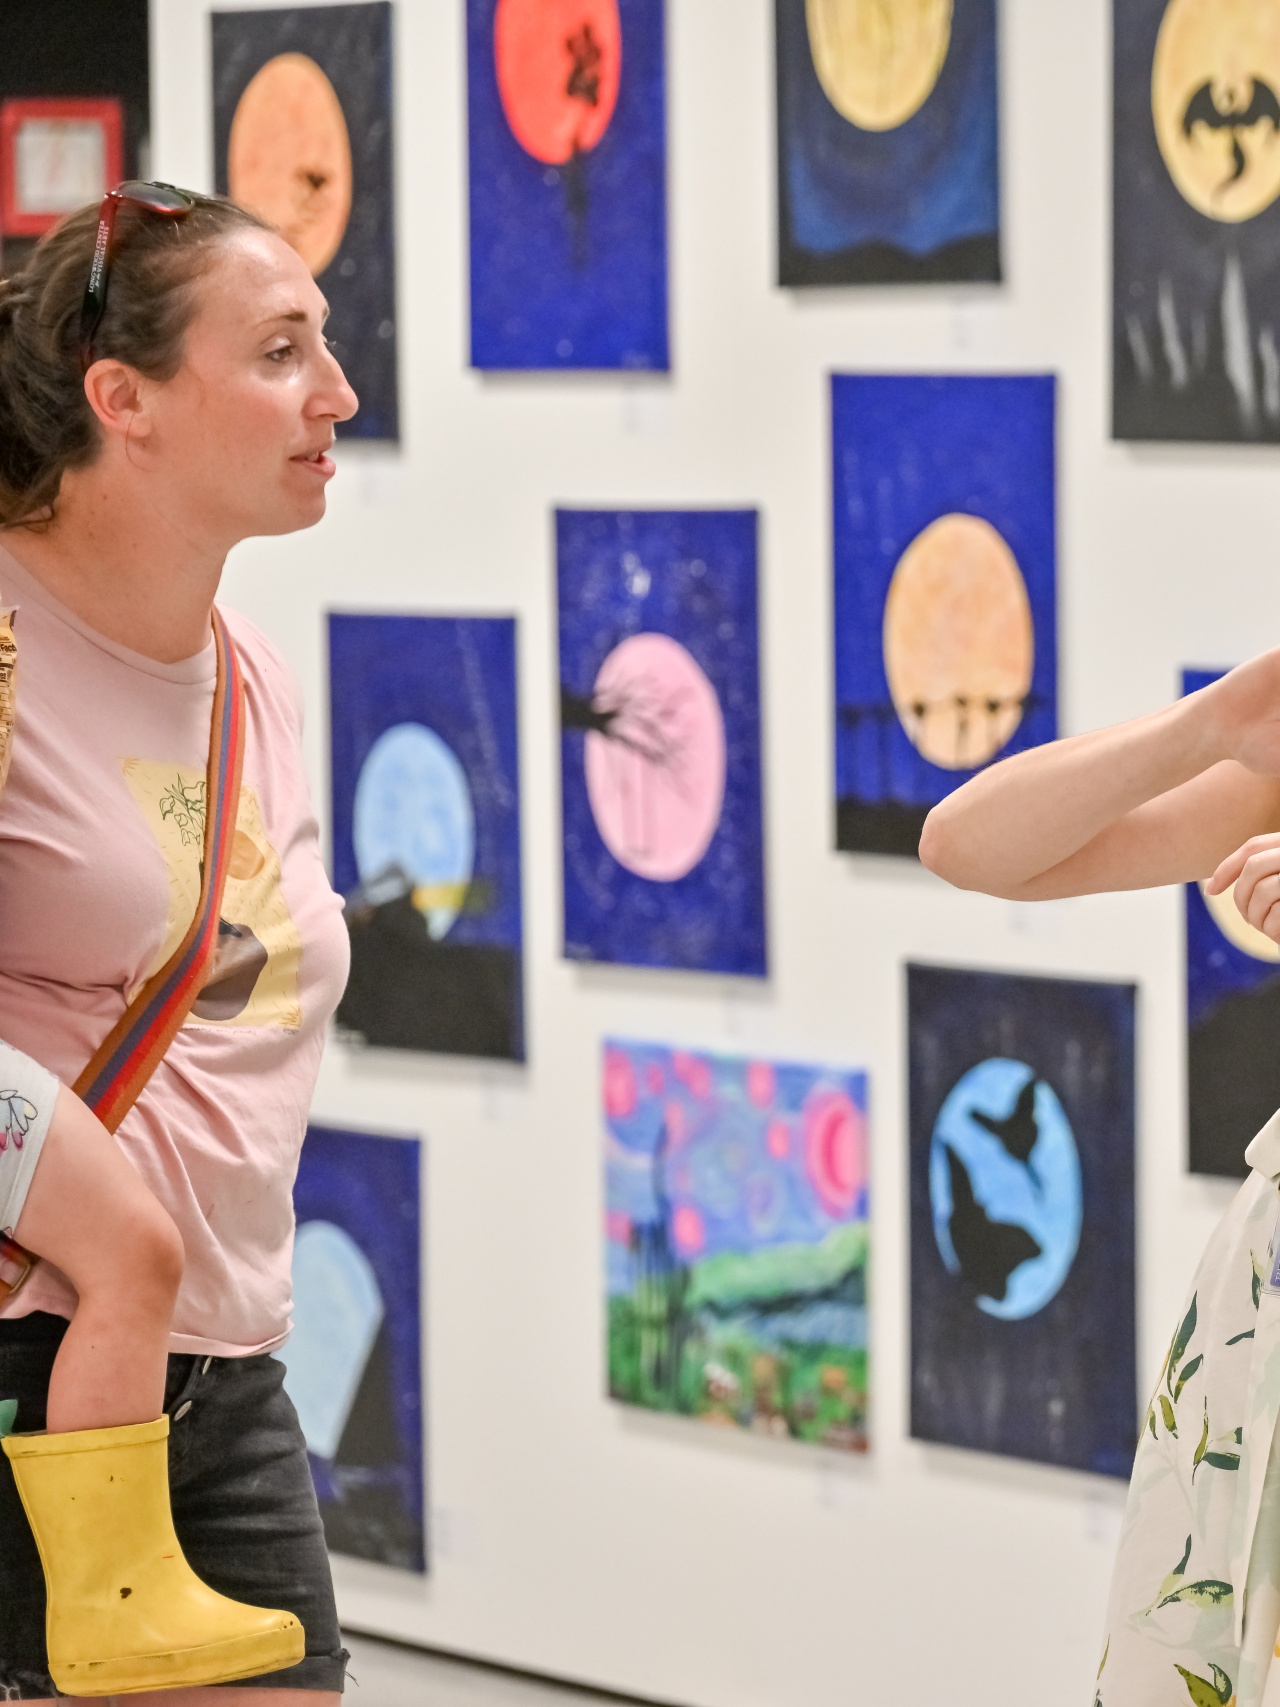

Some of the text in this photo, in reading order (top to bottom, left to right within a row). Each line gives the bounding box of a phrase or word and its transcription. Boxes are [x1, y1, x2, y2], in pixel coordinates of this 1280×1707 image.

[101, 226, 109, 245] ARTS
[88, 220, 105, 293] LONGWOOD CENTER
[97, 245, 106, 273] VISUAL
